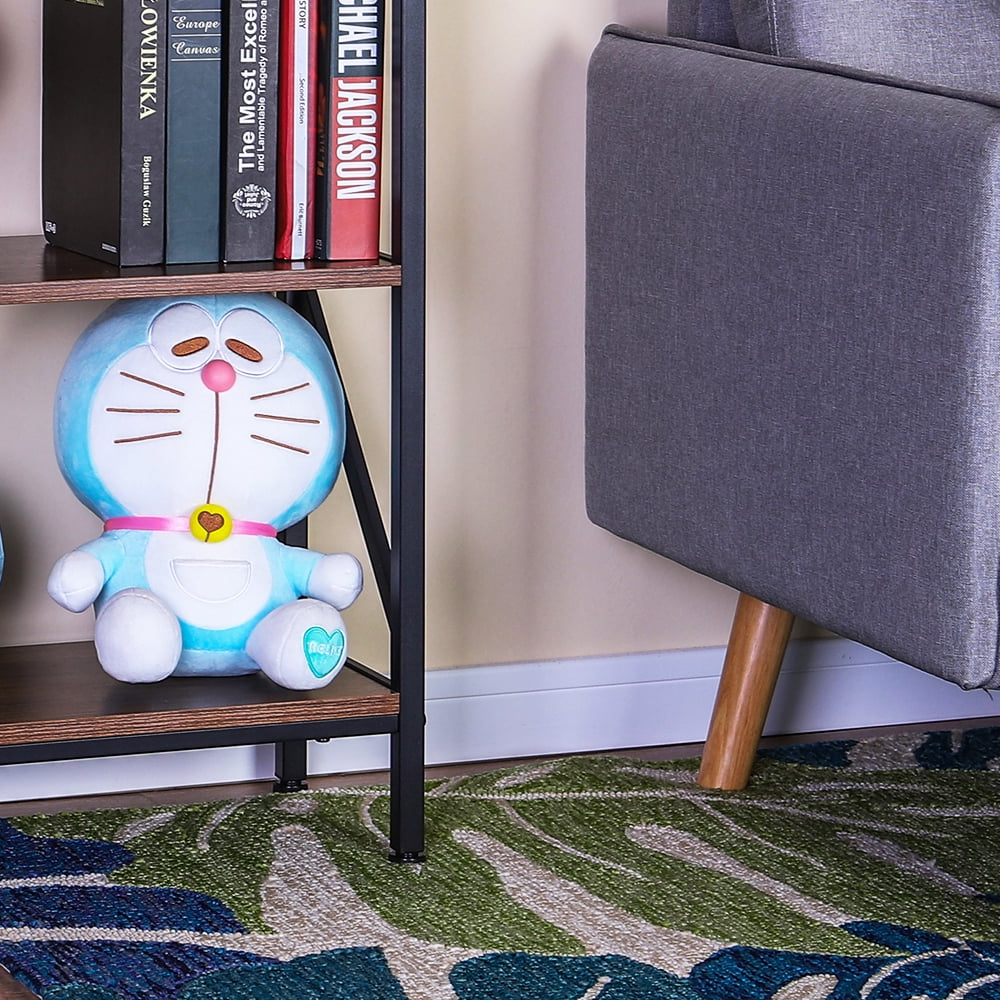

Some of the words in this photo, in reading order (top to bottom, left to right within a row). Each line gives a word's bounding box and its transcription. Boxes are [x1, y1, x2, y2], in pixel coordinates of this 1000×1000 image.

[172, 15, 221, 33] Europe
[258, 8, 267, 42] Romeo
[171, 41, 221, 55] Canvas
[258, 44, 267, 54] of
[257, 55, 268, 95] Tragedy
[239, 69, 257, 124] Most
[256, 96, 266, 152] Lamentable
[336, 79, 378, 200] JACKSON
[238, 131, 256, 173] The
[256, 153, 265, 172] and
[142, 199, 152, 227] Guzik
